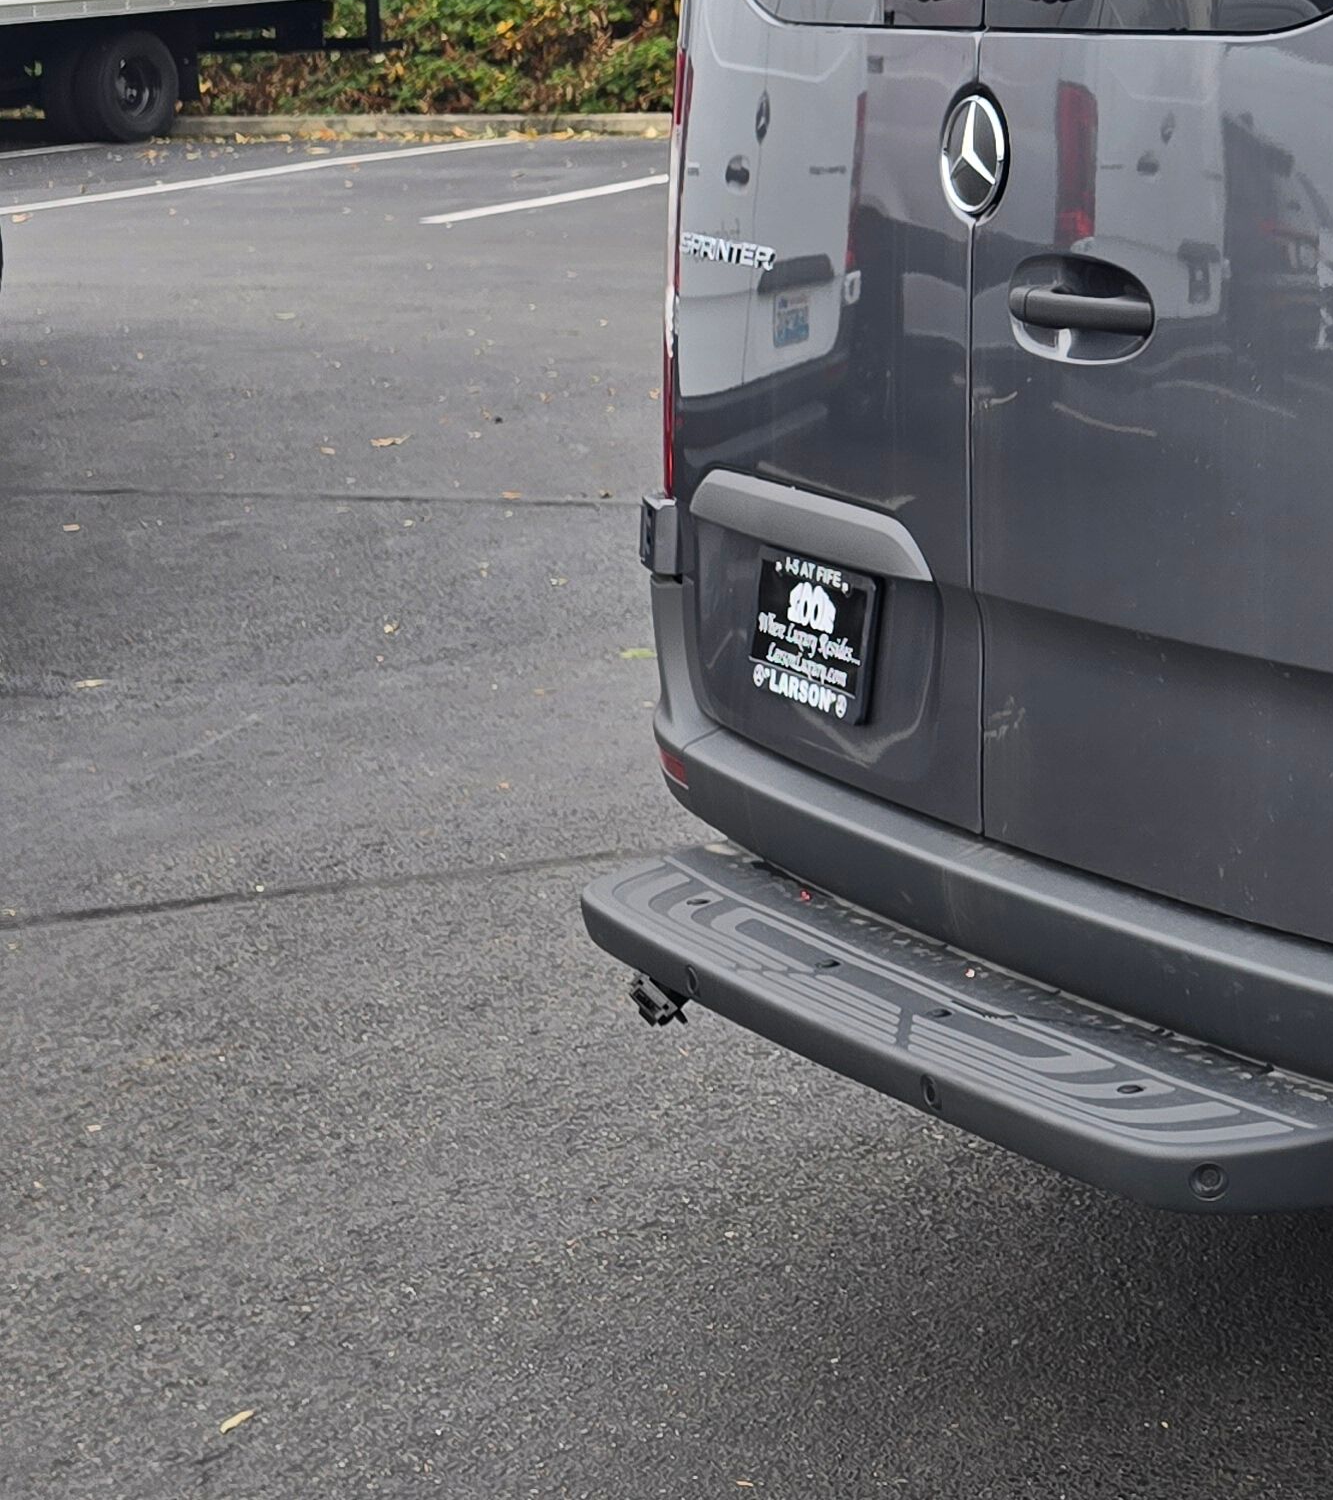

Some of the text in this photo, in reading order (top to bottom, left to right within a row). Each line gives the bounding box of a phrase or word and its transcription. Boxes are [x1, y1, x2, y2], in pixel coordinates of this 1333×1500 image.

[680, 231, 776, 271] SPRINTER
[800, 561, 816, 580] AT
[816, 566, 842, 588] FIFE
